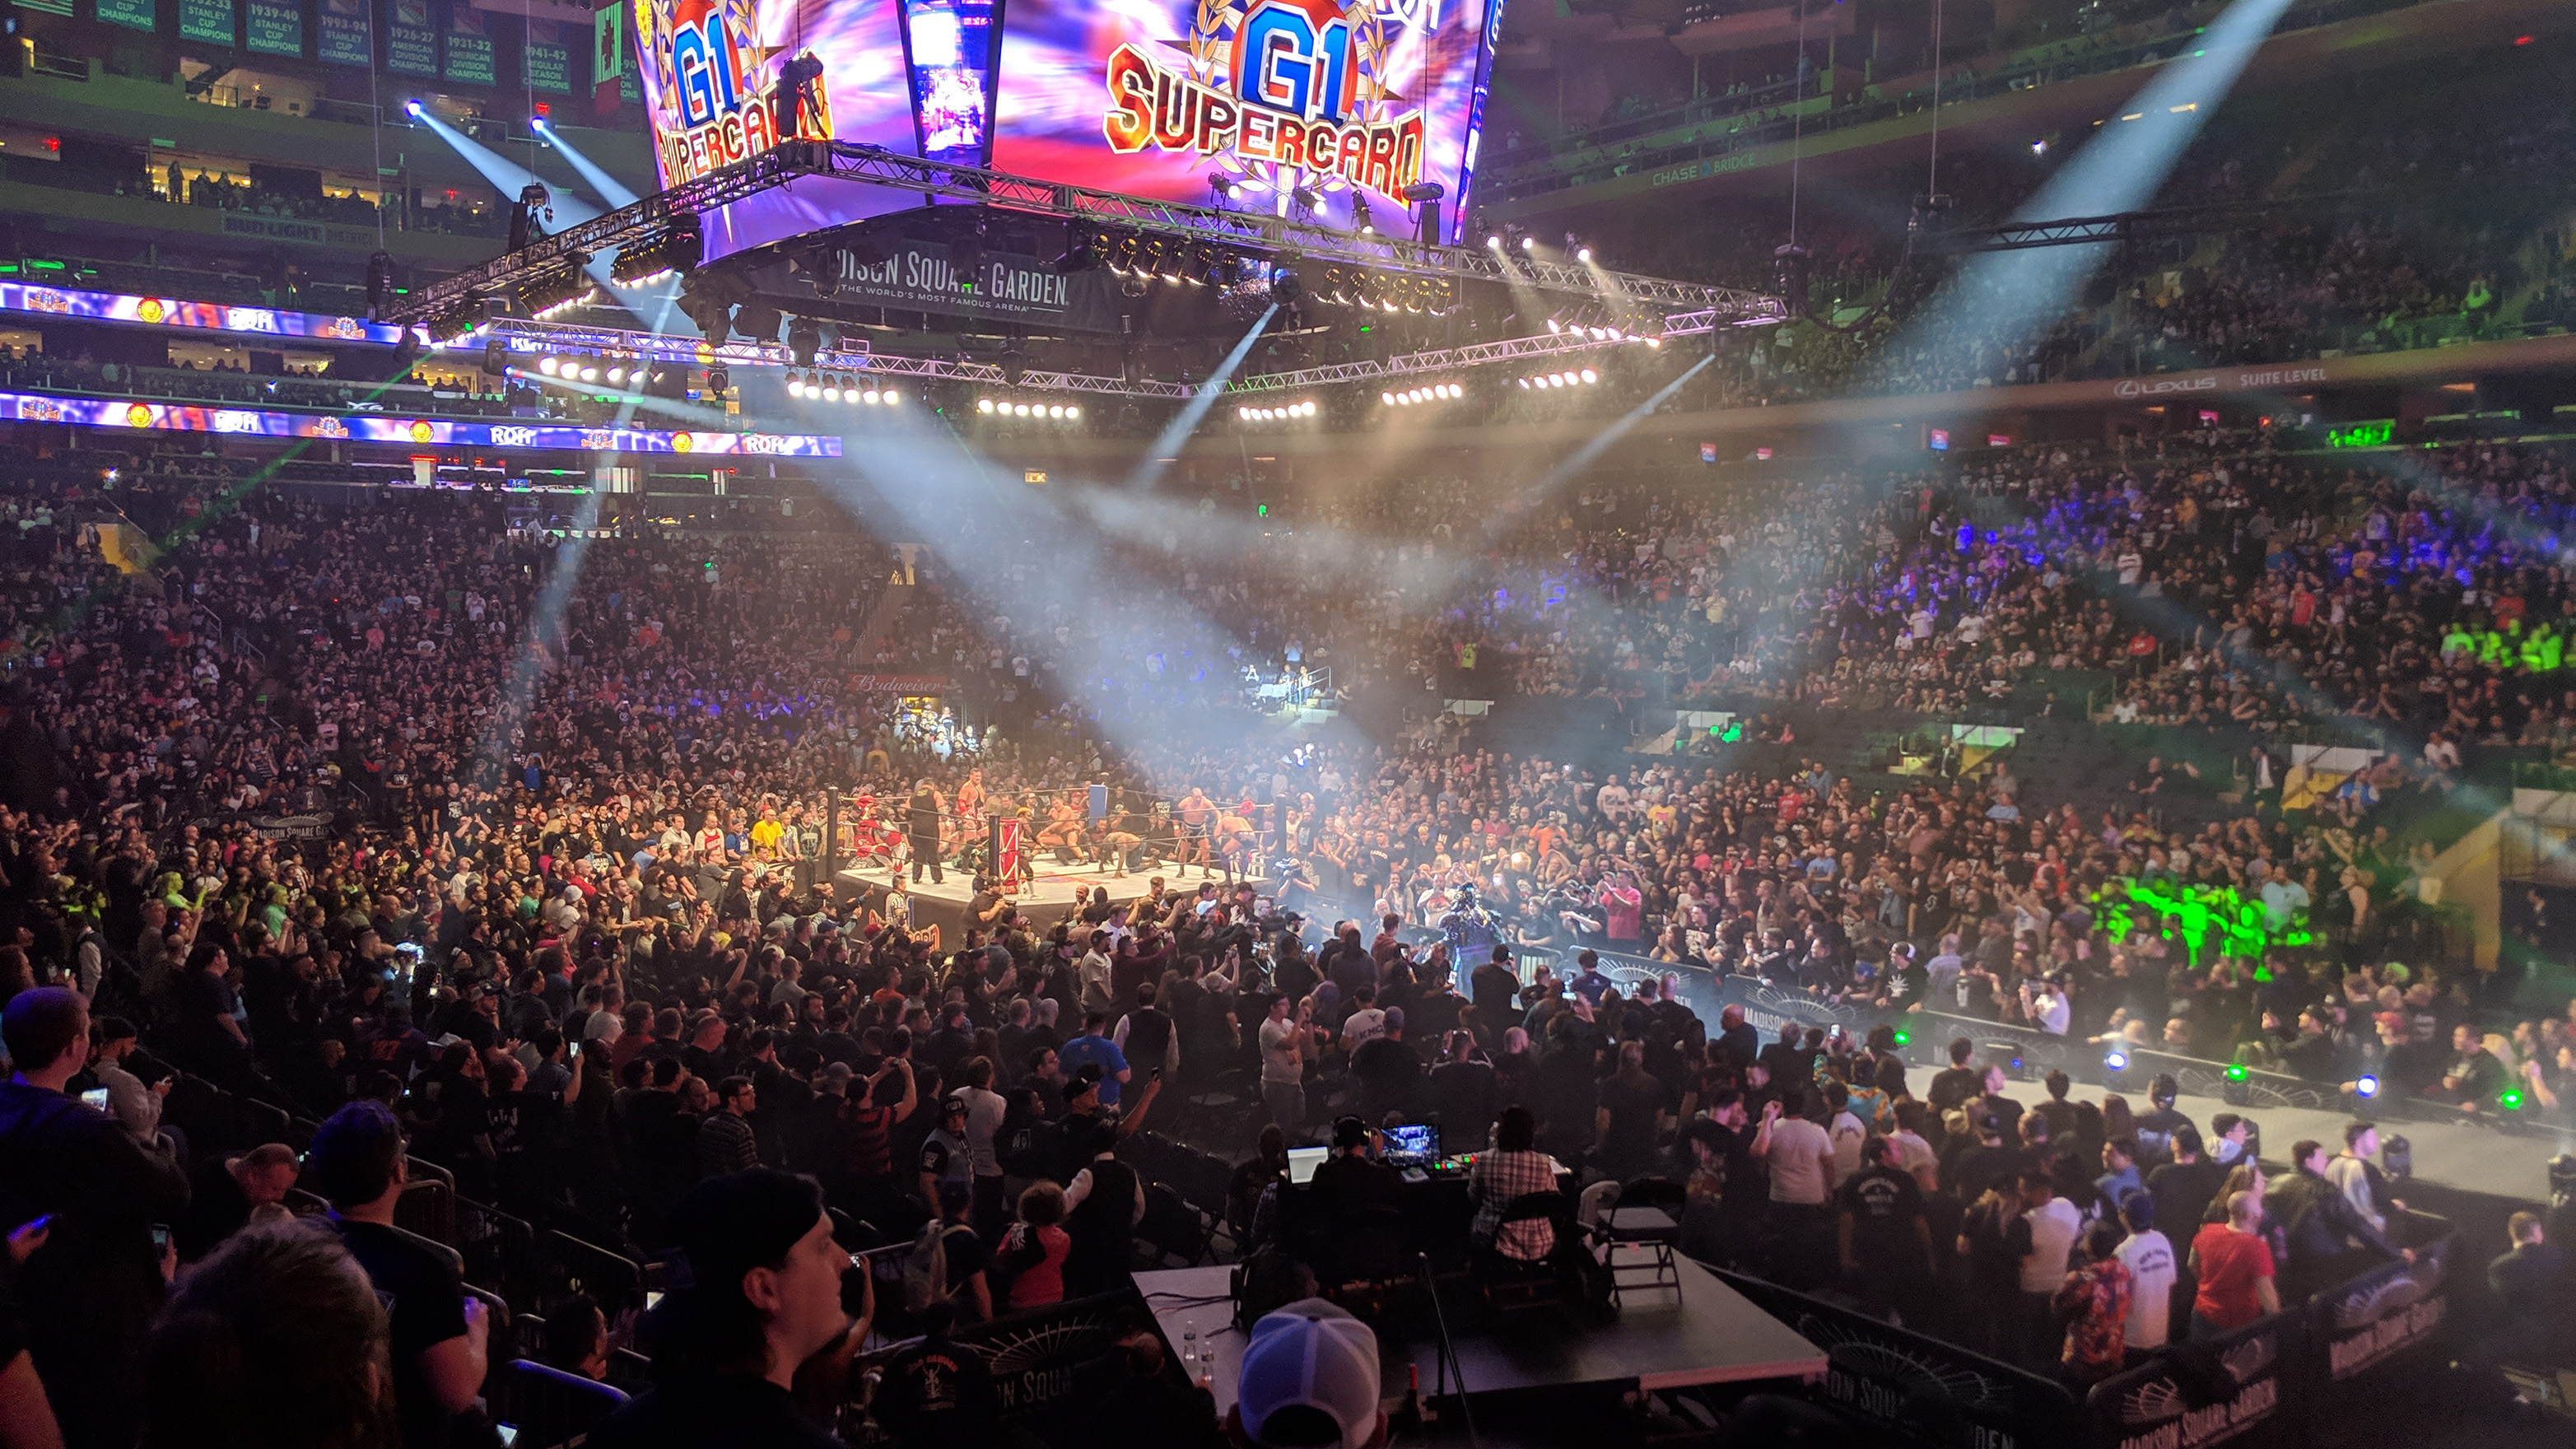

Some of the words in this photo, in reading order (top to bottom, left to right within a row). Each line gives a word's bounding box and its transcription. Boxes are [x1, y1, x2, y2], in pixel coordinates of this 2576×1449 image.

[98, 9, 153, 27] CHAMPIONS
[189, 6, 226, 21] STANLEY
[250, 4, 299, 21] 1939-40
[198, 17, 217, 29] CUP
[254, 19, 294, 32] STANLEY
[181, 24, 233, 41] CHAMPIONS
[265, 30, 284, 40] CUP
[325, 30, 362, 43] STANLEY
[390, 26, 435, 43] 1926-27
[249, 37, 300, 53] CHAMPIONS
[335, 42, 353, 51] CUP
[391, 41, 433, 54] AMERICAN
[448, 35, 492, 51] 1931-32
[319, 49, 369, 63] CHAMPIONS
[395, 51, 431, 63] DIVISION
[449, 51, 491, 62] AMERICAN
[1236, 0, 1353, 127] G1
[389, 59, 437, 73] CHAMPIONS
[453, 60, 487, 71] DIVISION
[445, 68, 494, 81] CHAMPIONS
[1102, 42, 1425, 211] SUPERCARD
[1652, 165, 1697, 185] CHASE
[1713, 153, 1754, 174] BRIDGE
[991, 262, 1069, 306] GARDEN
[841, 284, 862, 294] THE
[865, 287, 914, 300] WORLD'S
[917, 293, 947, 304] MOST
[950, 297, 991, 310] FAMOUS
[2141, 376, 2217, 394] LEXUS
[2240, 372, 2281, 387] SUITE
[2285, 368, 2327, 384] LEVEL
[853, 674, 940, 692] Budweiser
[1745, 1007, 1782, 1030] MADISO
